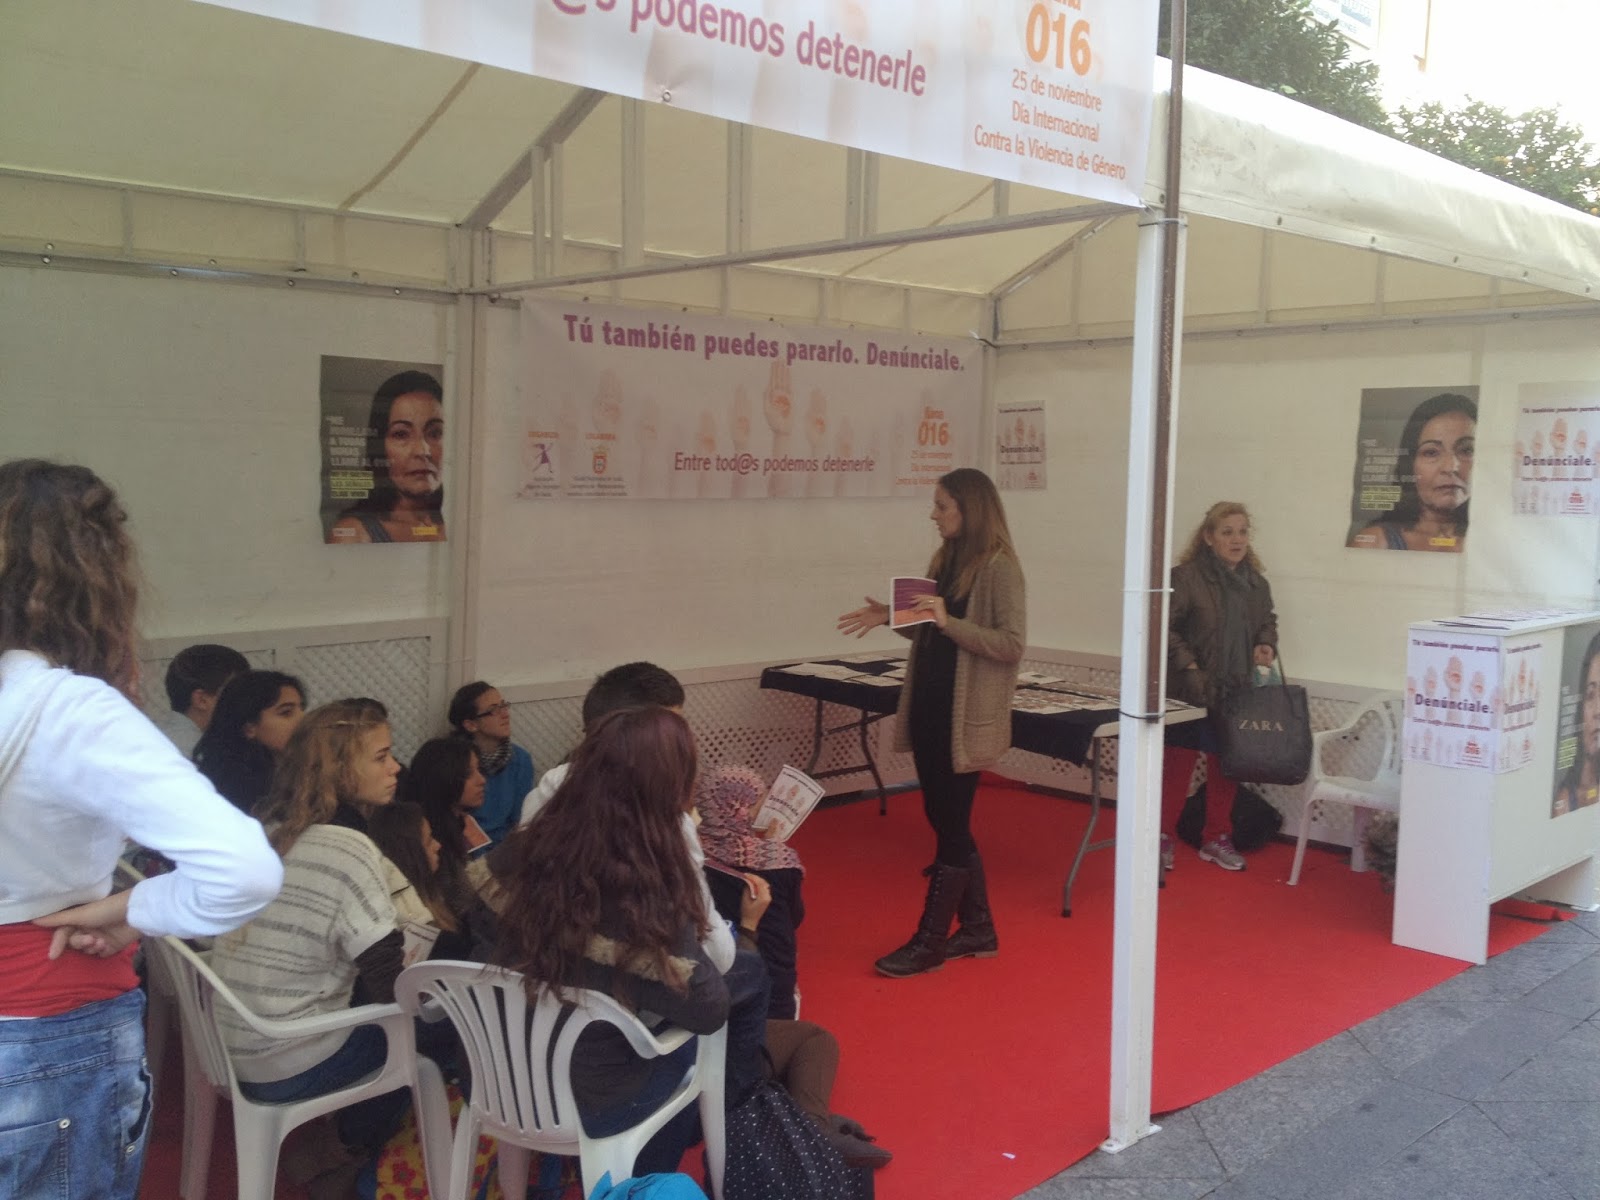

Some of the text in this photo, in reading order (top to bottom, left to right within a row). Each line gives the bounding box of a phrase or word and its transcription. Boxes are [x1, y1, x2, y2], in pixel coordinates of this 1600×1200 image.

[630, 0, 926, 97] podemos detenerle
[1026, 3, 1091, 76] 016
[1012, 68, 1102, 112] 25 de noviembre
[1012, 100, 1100, 142] Día Internacional
[974, 124, 1126, 180] Contra la Violencia de Género
[563, 313, 965, 371] Tú también puedes pararlo. Denúnciale.
[918, 421, 949, 446] 016
[674, 451, 875, 476] Entre tod@s podemos detenerle
[1238, 719, 1284, 731] ZARA
[1415, 693, 1494, 714] Denúnciale.
